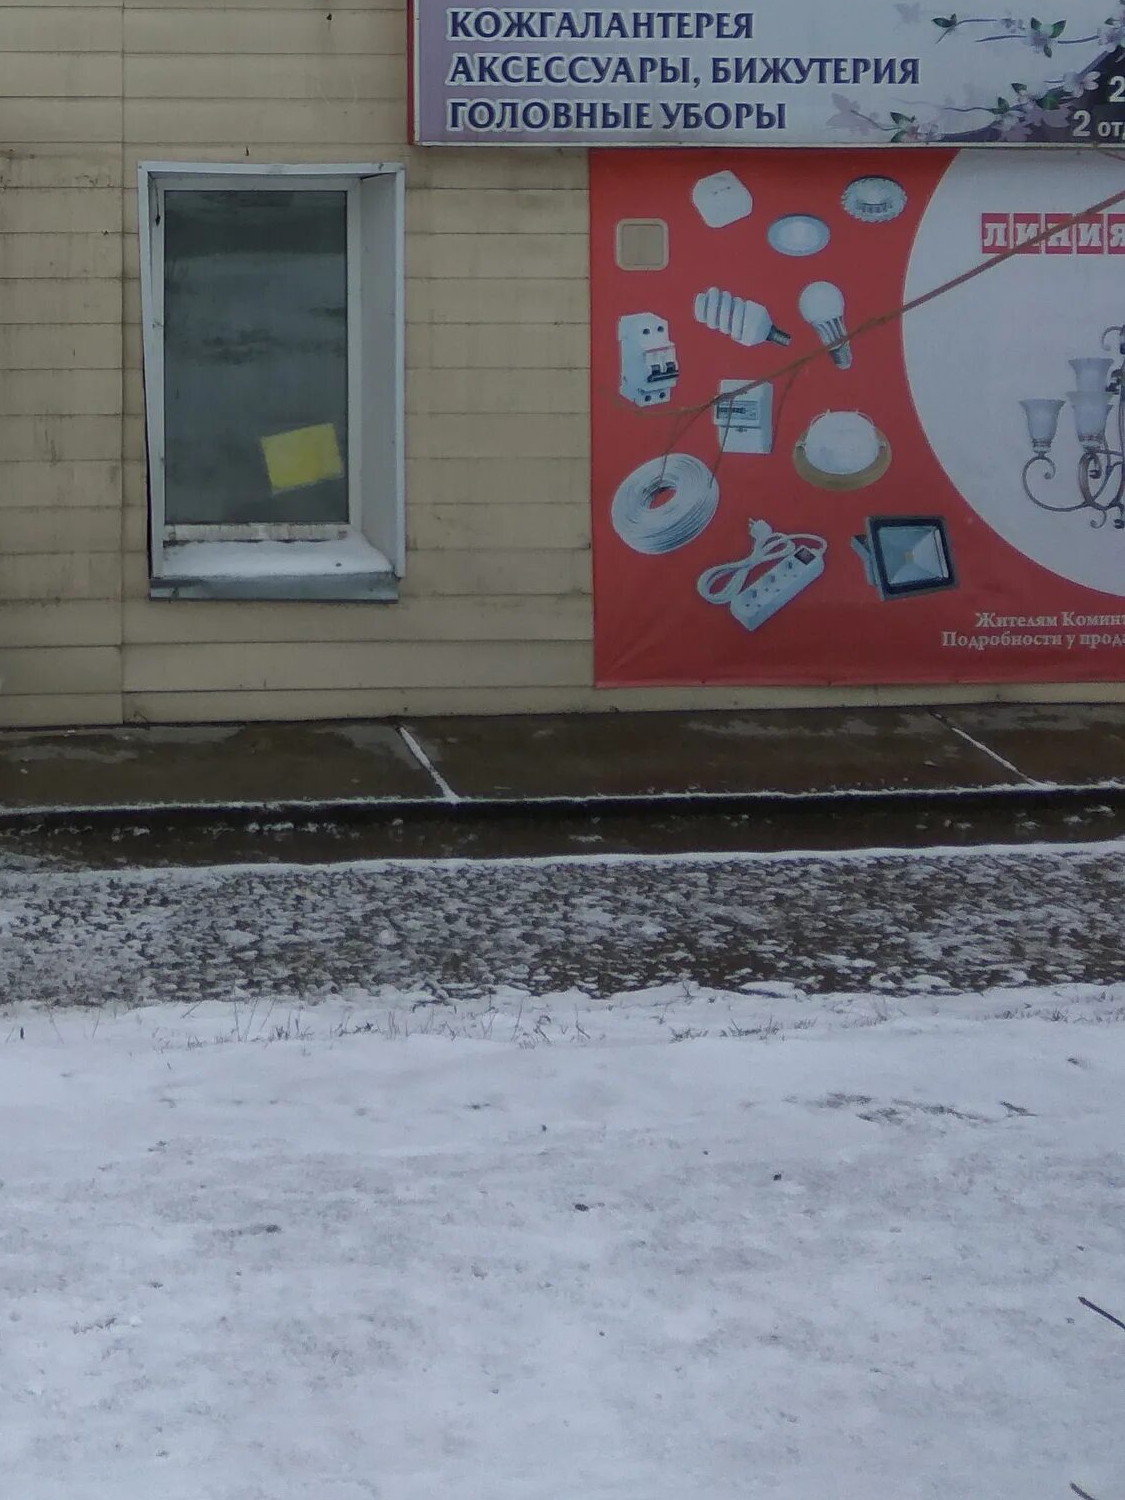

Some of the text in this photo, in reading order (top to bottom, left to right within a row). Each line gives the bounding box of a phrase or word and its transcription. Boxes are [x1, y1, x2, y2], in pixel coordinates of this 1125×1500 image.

[449, 10, 755, 40] КОЖГАЛАНТЕРЕЯ
[448, 56, 920, 88] АКСЕССУАРЫ, БИЖУТЕРИЯ
[449, 101, 786, 131] ГОЛОВНЫЕ УБОРЫ
[1073, 110, 1125, 141] 2 от
[975, 612, 1059, 628] Жителям
[941, 631, 1062, 650] Подробности
[1065, 634, 1076, 650] у
